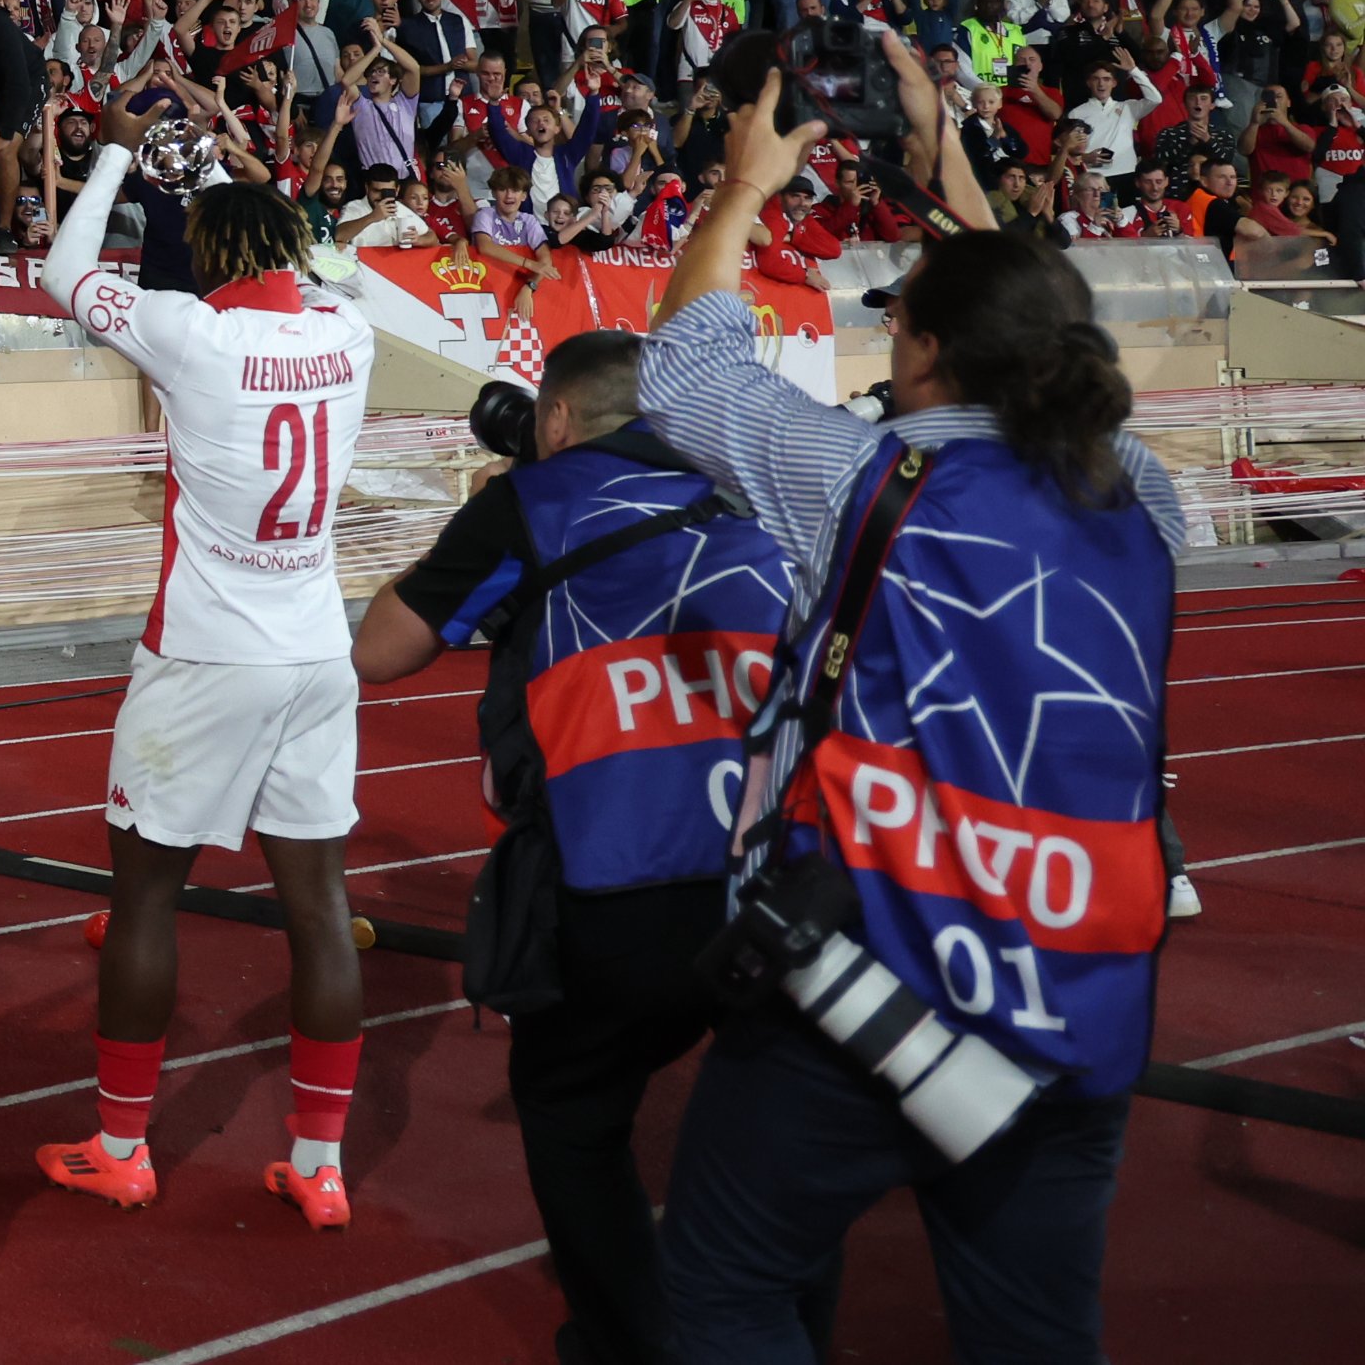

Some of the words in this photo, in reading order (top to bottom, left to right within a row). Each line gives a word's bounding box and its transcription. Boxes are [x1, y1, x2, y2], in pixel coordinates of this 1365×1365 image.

[592, 245, 677, 269] MUNEG
[242, 350, 353, 392] ILENIKHENA
[255, 400, 329, 542] 21
[209, 544, 236, 562] AS
[824, 631, 850, 680] EOS
[932, 924, 1067, 1033] 01
